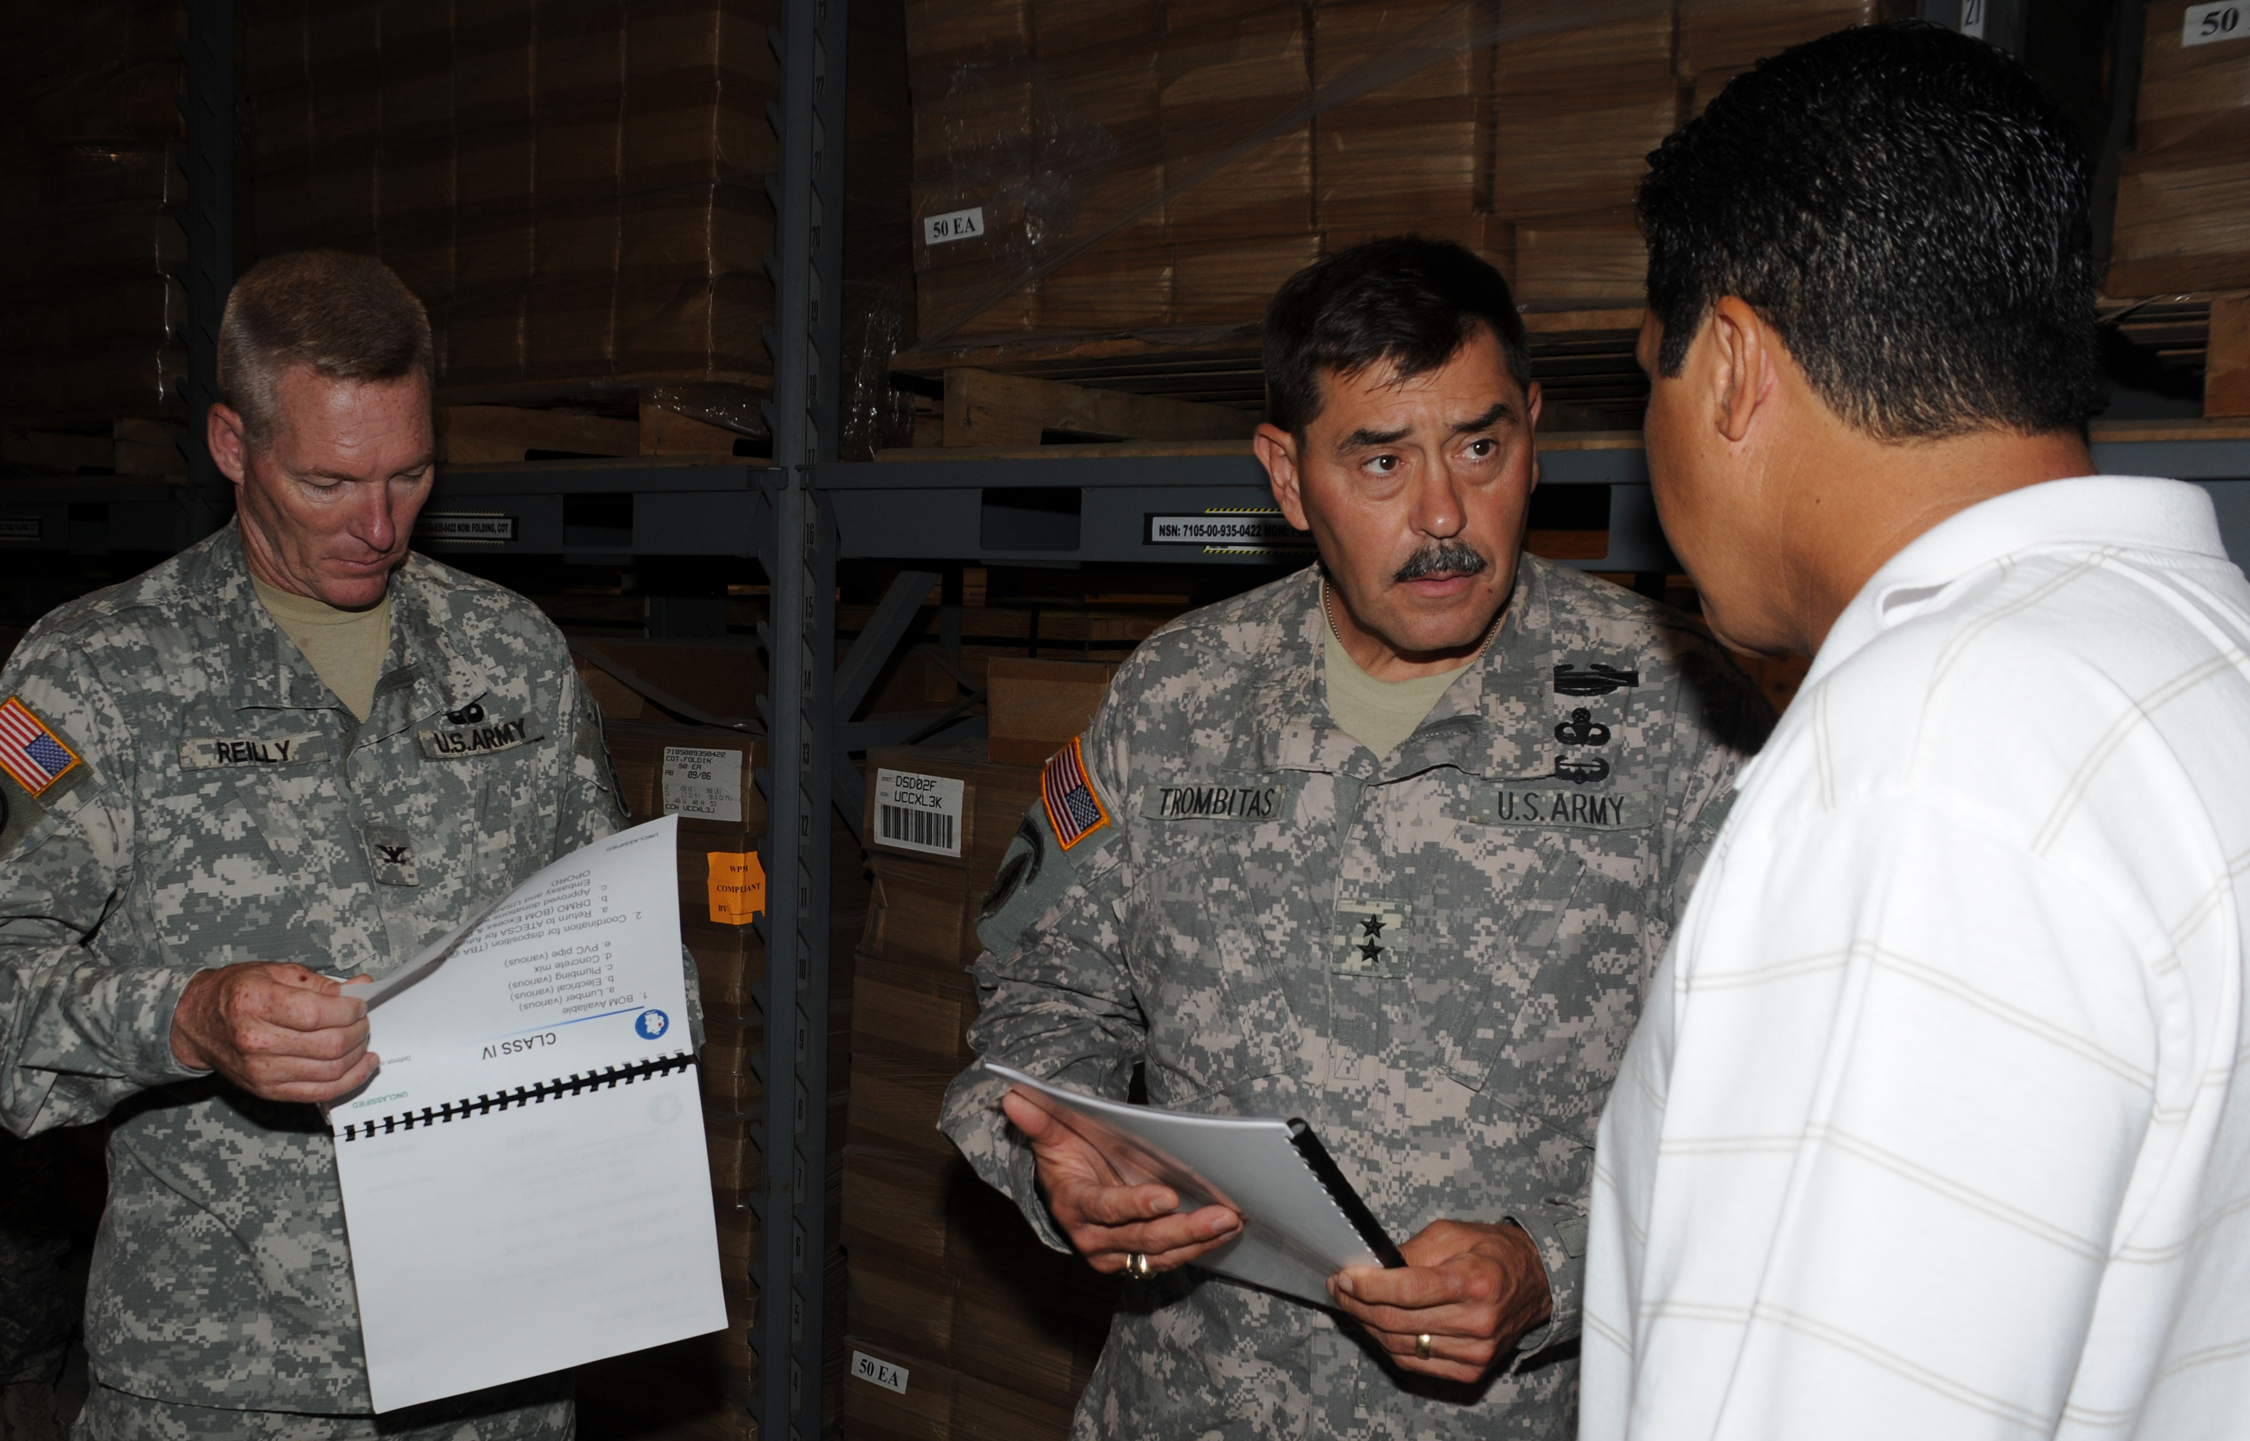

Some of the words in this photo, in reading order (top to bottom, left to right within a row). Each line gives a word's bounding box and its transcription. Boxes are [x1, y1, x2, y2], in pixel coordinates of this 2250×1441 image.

[2200, 7, 2239, 36] 50
[933, 220, 949, 238] 50
[953, 216, 976, 235] EA
[811, 300, 819, 322] 19
[809, 374, 817, 397] 18
[497, 523, 508, 532] COT
[806, 523, 815, 545] 16
[1159, 524, 1181, 537] NSN:
[1183, 524, 1261, 537] 7105-00-935-0422
[1264, 525, 1289, 537] NOM:
[805, 597, 814, 618] 15
[804, 670, 811, 692] 14
[217, 739, 291, 764] REILLY
[802, 743, 810, 764] 13
[688, 771, 711, 780] 09/06
[895, 775, 937, 792] DSD02F
[894, 790, 943, 809] UCCXL3K
[1160, 786, 1275, 817] TROMBITAS
[801, 815, 809, 837] 12
[545, 879, 591, 896] Embassy
[716, 882, 761, 893] COMPLIANT
[524, 892, 543, 902] and
[543, 888, 591, 905] Approved
[800, 887, 807, 908] 11
[493, 902, 541, 920] donations
[525, 906, 554, 920] (BOM
[557, 898, 591, 913] DRMO
[718, 904, 728, 912] BY
[487, 915, 522, 929] Excess
[558, 909, 592, 922] Return
[563, 914, 627, 933] Coordination
[484, 931, 497, 940] for
[500, 920, 544, 937] ATECSA
[547, 927, 561, 936] for
[491, 930, 545, 948] disposition
[463, 942, 489, 956] (TBA
[551, 946, 573, 959] pipe
[576, 943, 599, 955] PVC
[504, 951, 548, 968] (various)
[554, 954, 600, 970] Concrete
[534, 963, 551, 974] mix
[555, 966, 601, 981] Plumbing
[798, 959, 806, 980] 10
[508, 974, 552, 991] (various)
[557, 977, 602, 993] Electrical
[510, 985, 554, 1002] (various)
[565, 989, 603, 1002] Lumber
[608, 994, 634, 1007] BOM
[518, 995, 563, 1012] (various)
[562, 999, 607, 1015] Available
[500, 1032, 557, 1054] CLASS
[799, 1029, 804, 1050] 9
[481, 1045, 497, 1060] IV
[352, 1091, 408, 1109] UNCLASSIFIED
[798, 1099, 803, 1120] 8
[797, 1169, 802, 1189] 7
[795, 1237, 801, 1257] 6
[794, 1305, 800, 1324] 5
[859, 1358, 875, 1377] 50
[878, 1366, 899, 1387] EA
[793, 1372, 798, 1392] 4
